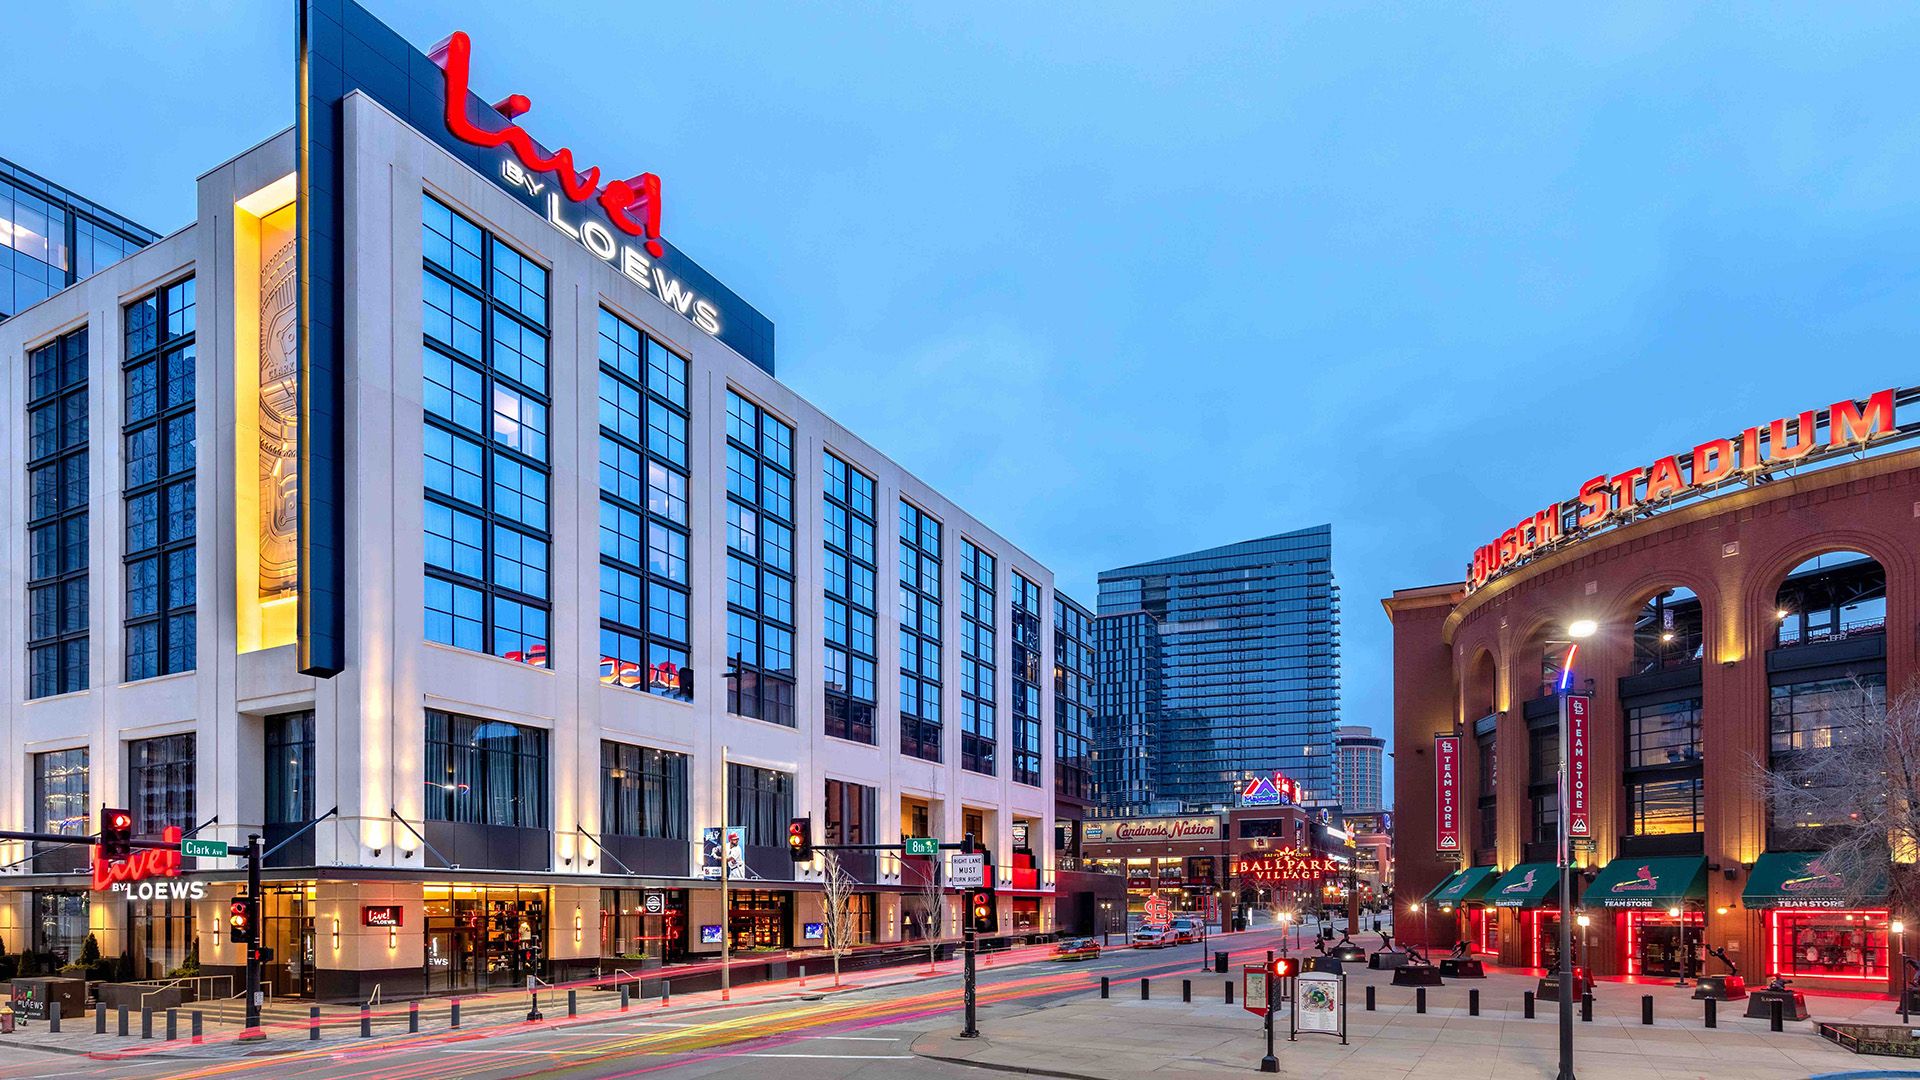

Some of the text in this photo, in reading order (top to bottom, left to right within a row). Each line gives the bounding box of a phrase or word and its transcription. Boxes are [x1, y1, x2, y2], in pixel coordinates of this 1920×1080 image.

[441, 30, 664, 258] Live!
[502, 159, 722, 335] BY LOEWS
[1473, 386, 1901, 588] BUSCH STADIUM
[1575, 719, 1583, 757] TEAM
[1443, 756, 1453, 787] TEAM
[1575, 761, 1584, 809] STORE
[1443, 789, 1453, 829] STORE
[1115, 822, 1168, 840] Cardinals
[1167, 820, 1214, 839] Nation
[185, 841, 224, 856] Clark Ave
[912, 840, 925, 853] 8th
[958, 866, 977, 874] MUST
[1239, 860, 1337, 873] BALLPARK
[1256, 871, 1320, 880] VILLAGE
[112, 881, 205, 901] BY LOEWS
[1777, 900, 1845, 908] TEAM STORE
[368, 908, 390, 922] Live!
